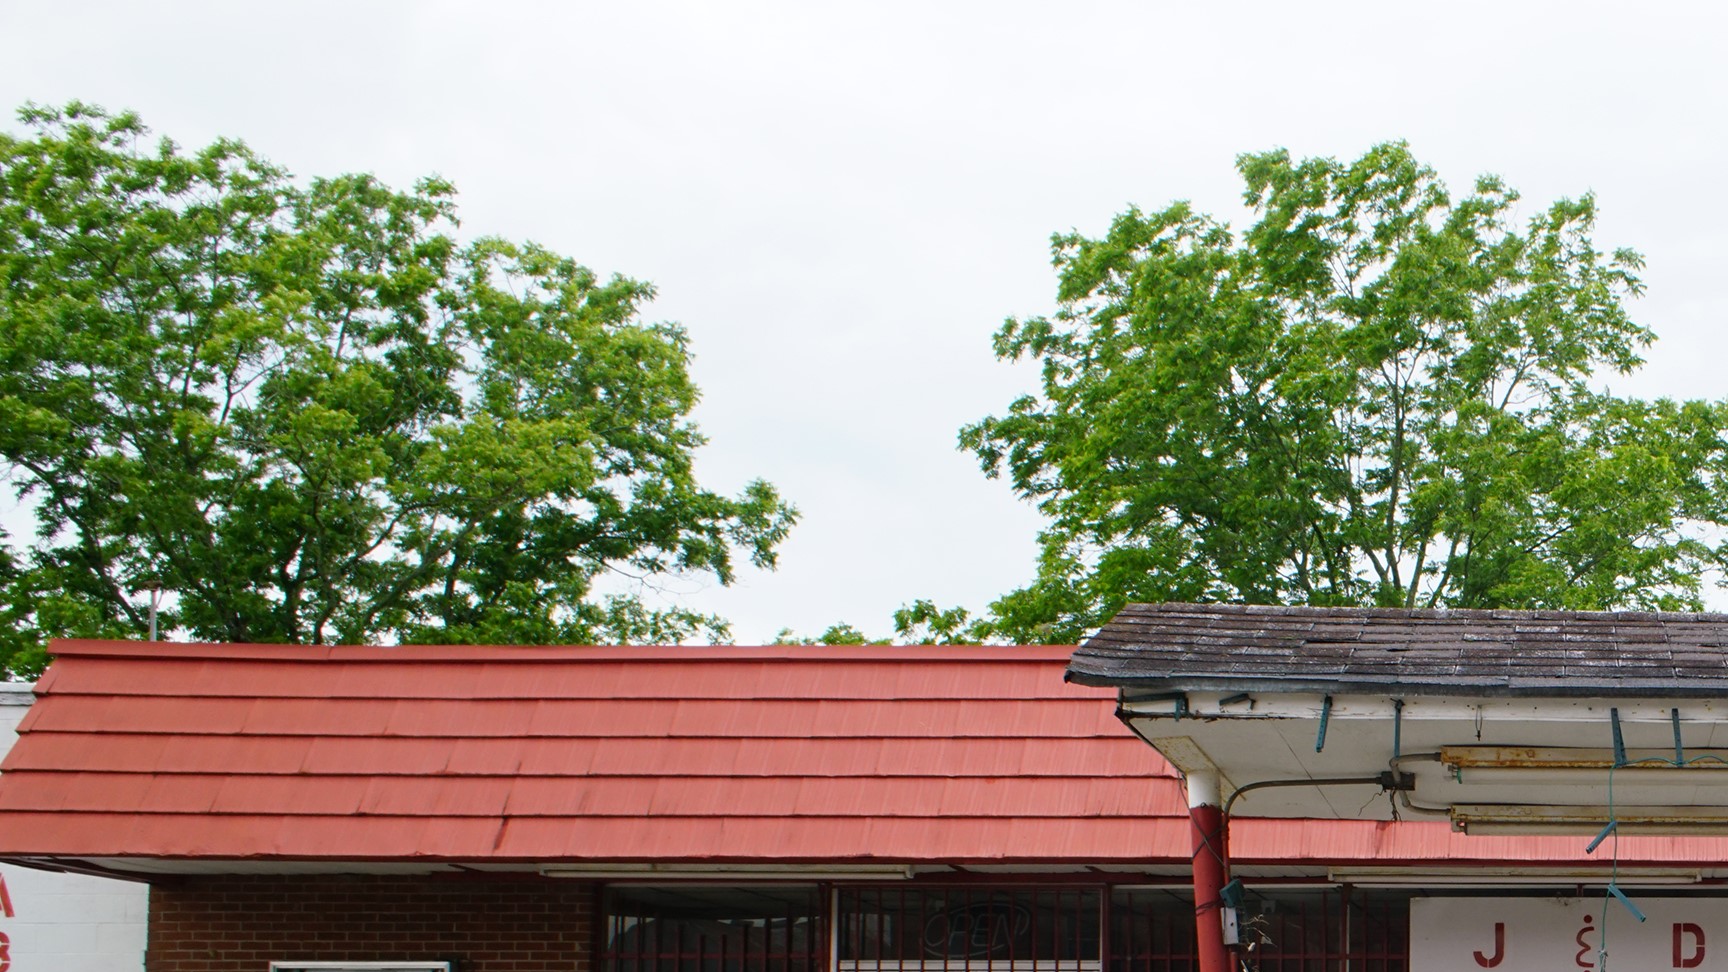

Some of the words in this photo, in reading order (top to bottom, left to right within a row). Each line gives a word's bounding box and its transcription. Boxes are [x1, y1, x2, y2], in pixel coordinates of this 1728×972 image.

[924, 912, 1022, 948] OPEN
[1473, 922, 1505, 969] J
[1672, 922, 1706, 969] D
